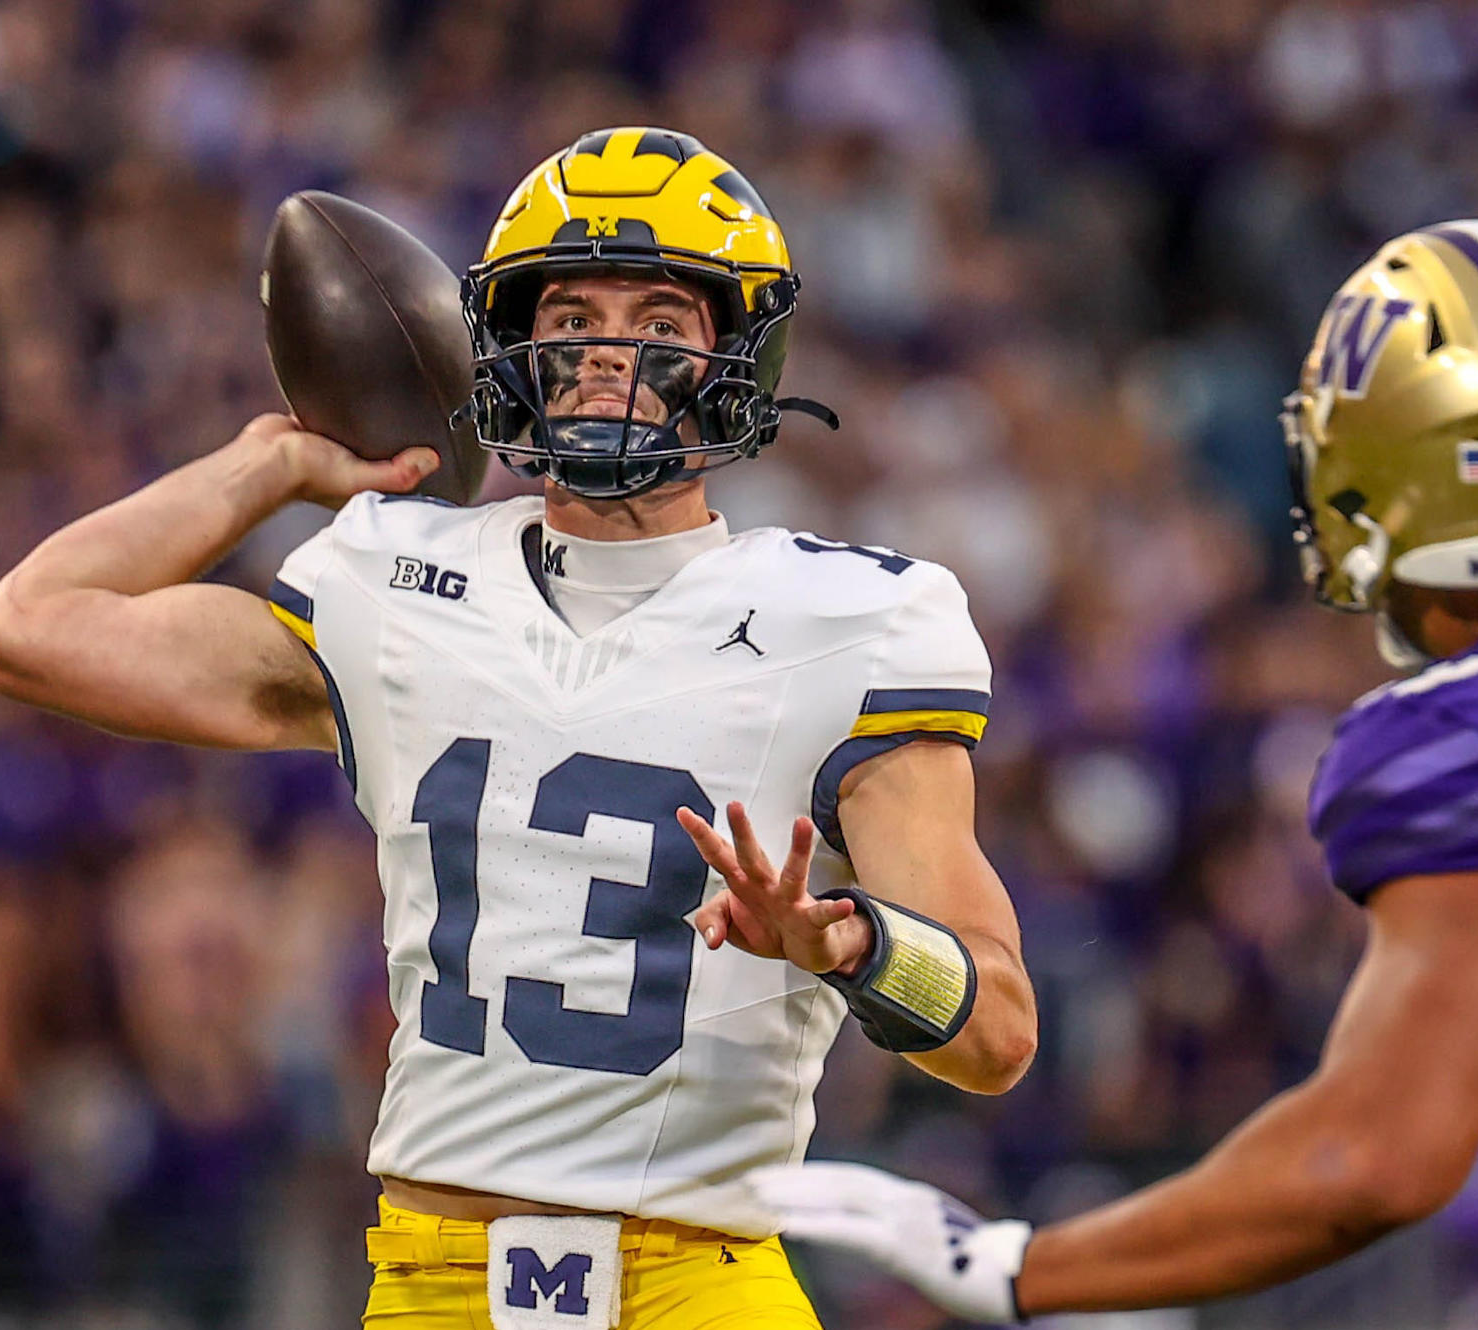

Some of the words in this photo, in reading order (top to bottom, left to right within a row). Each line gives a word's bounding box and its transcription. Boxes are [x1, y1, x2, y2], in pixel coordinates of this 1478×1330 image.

[586, 216, 619, 237] M
[1319, 295, 1416, 398] W
[543, 540, 568, 578] M
[411, 736, 716, 1077] 13
[506, 1247, 593, 1316] M
